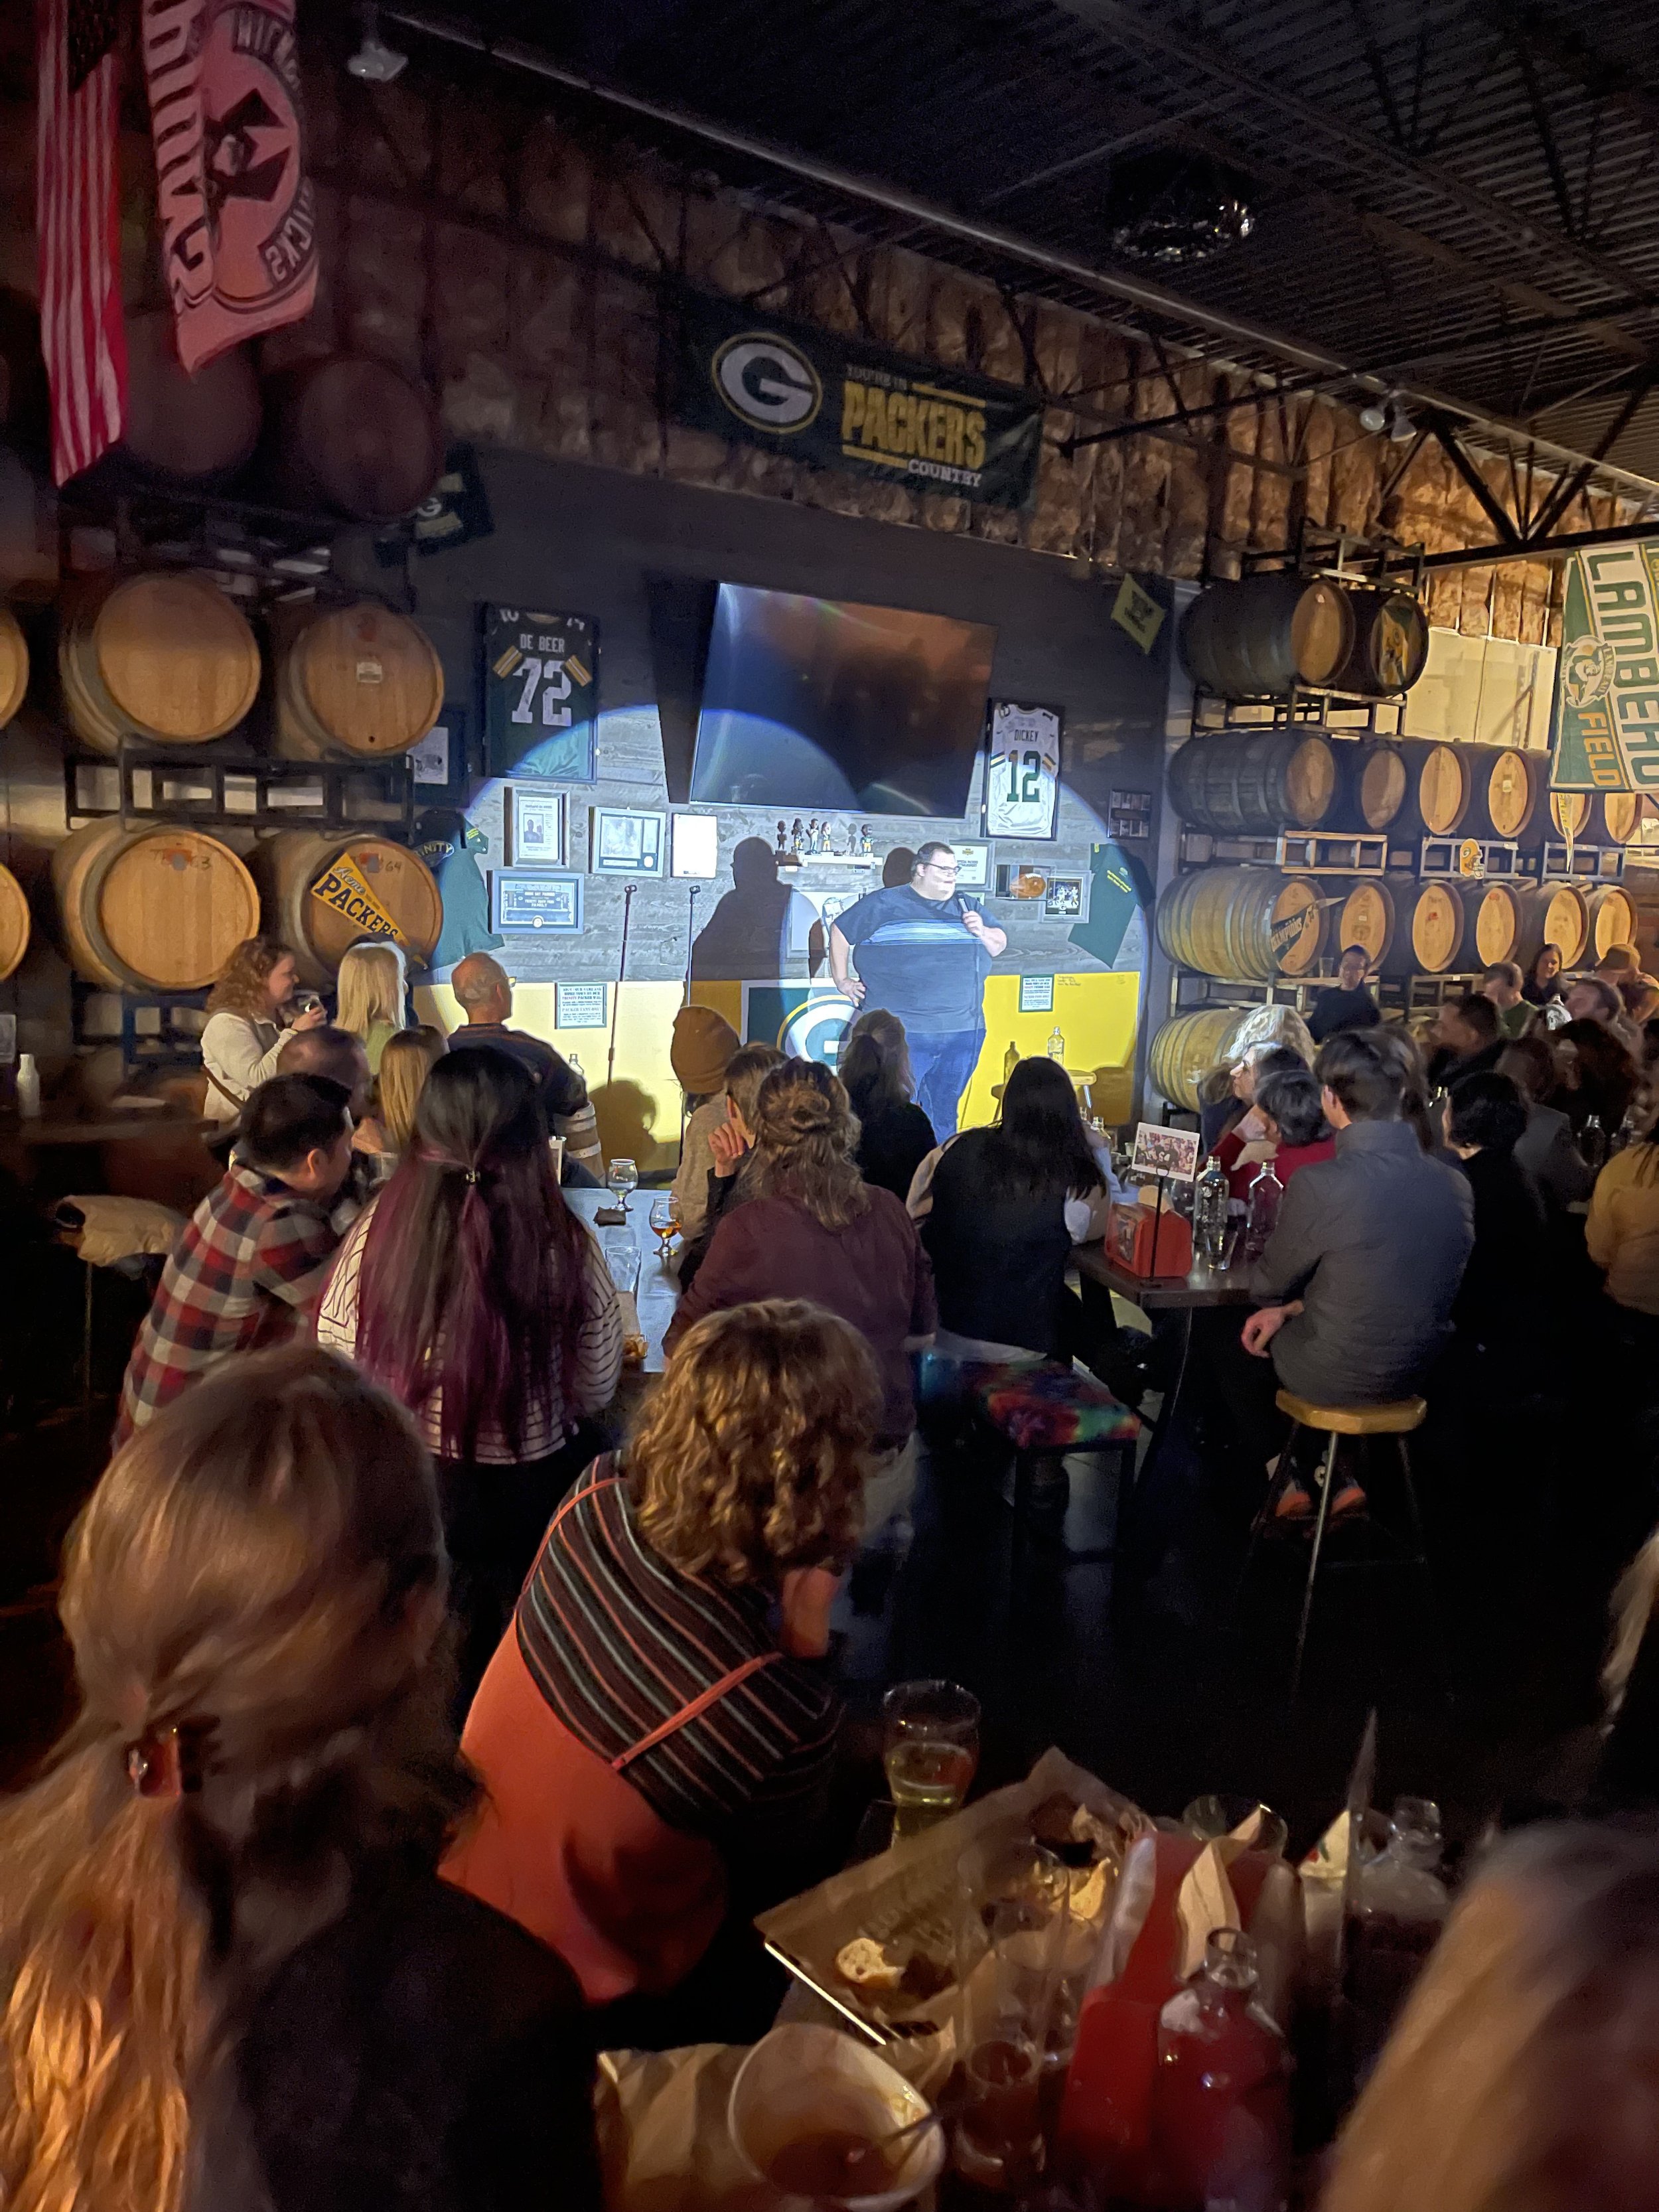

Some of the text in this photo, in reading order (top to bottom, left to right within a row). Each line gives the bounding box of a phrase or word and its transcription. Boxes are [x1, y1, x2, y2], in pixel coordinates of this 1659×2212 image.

[842, 380, 986, 470] PACKERS
[908, 458, 983, 487] COUNTRY
[520, 633, 565, 653] DE BEER
[1587, 550, 1659, 785] LAMBEAU
[512, 657, 572, 727] 72
[1014, 729, 1039, 742] DICKEY
[1577, 711, 1622, 786] FIELD
[1007, 749, 1041, 802] 12
[314, 872, 399, 935] PACKERS
[333, 866, 366, 895] Acme
